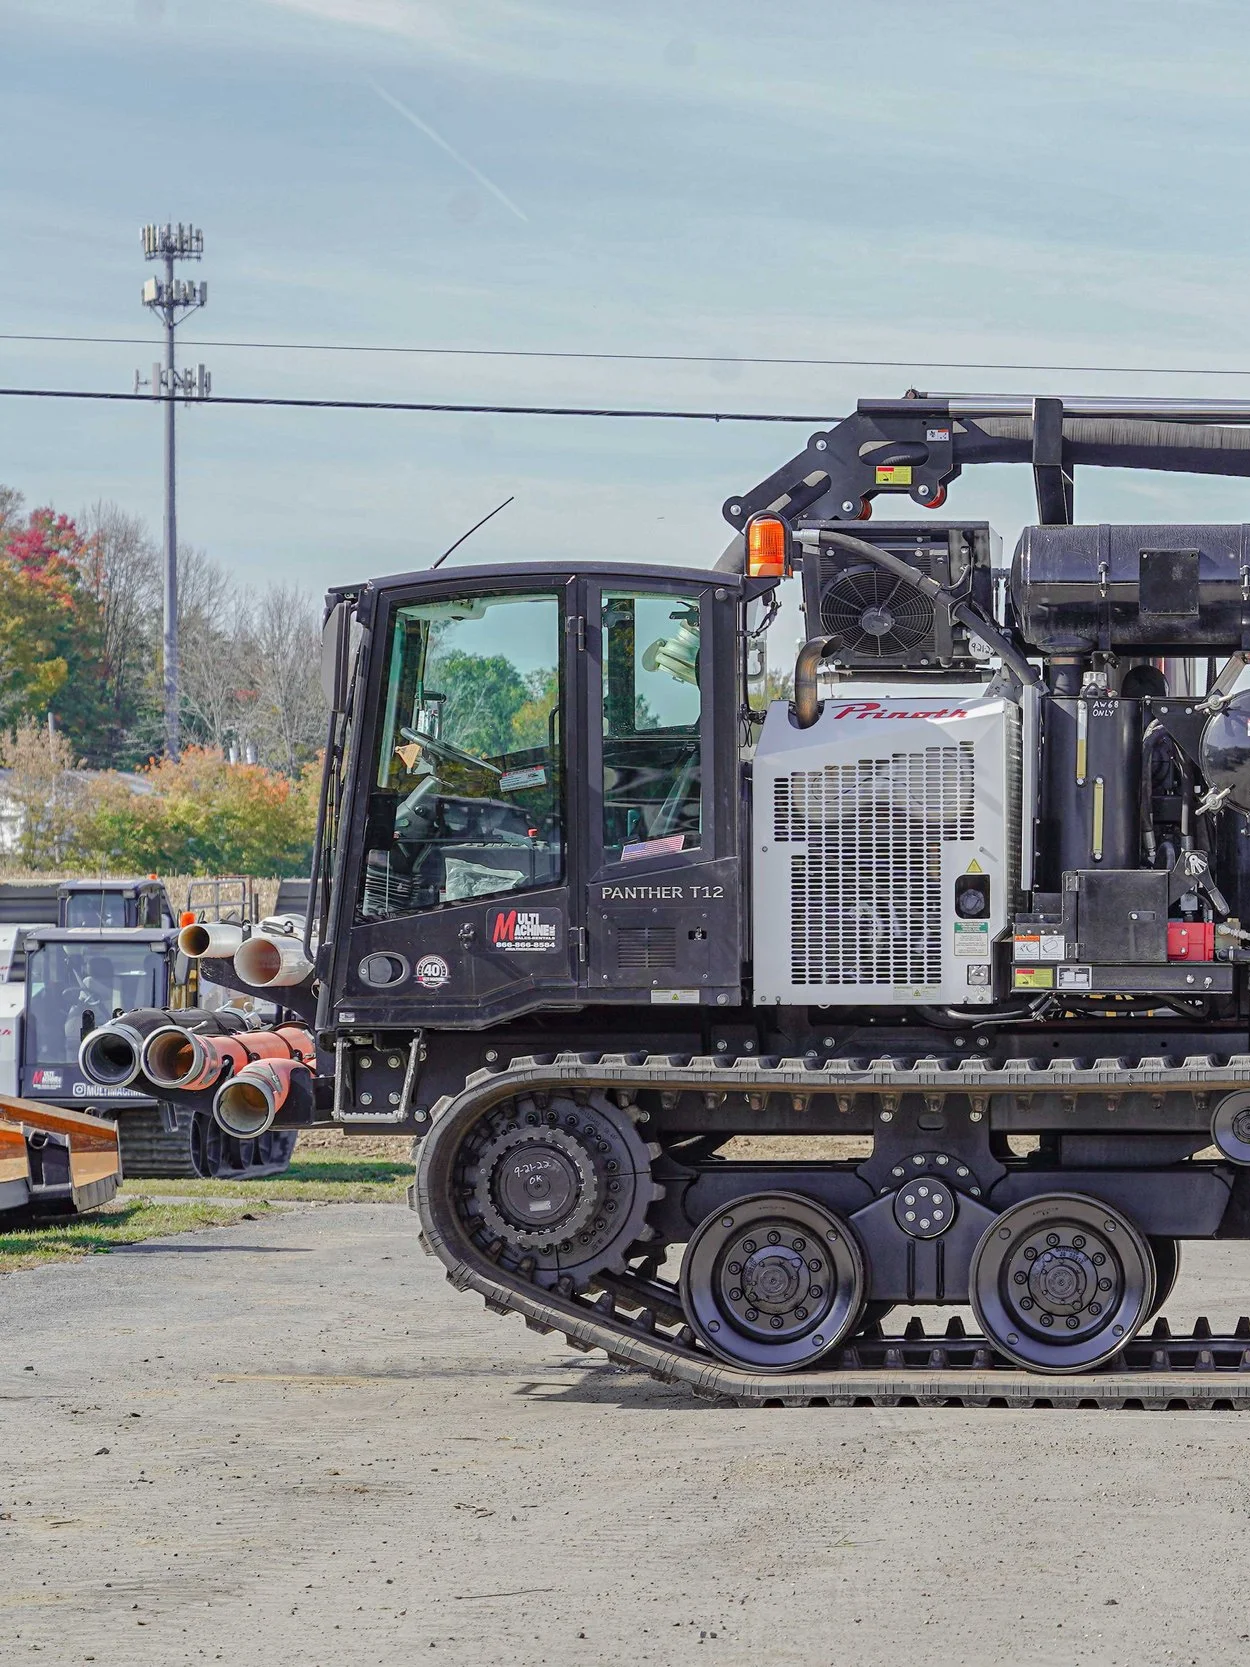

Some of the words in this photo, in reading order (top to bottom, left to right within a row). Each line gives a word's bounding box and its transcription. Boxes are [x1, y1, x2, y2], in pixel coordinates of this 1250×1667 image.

[832, 703, 967, 720] Prinoth
[602, 886, 683, 899] PANTHER
[689, 886, 724, 898] T12
[423, 964, 440, 977] 40
[529, 1175, 543, 1185] OK
